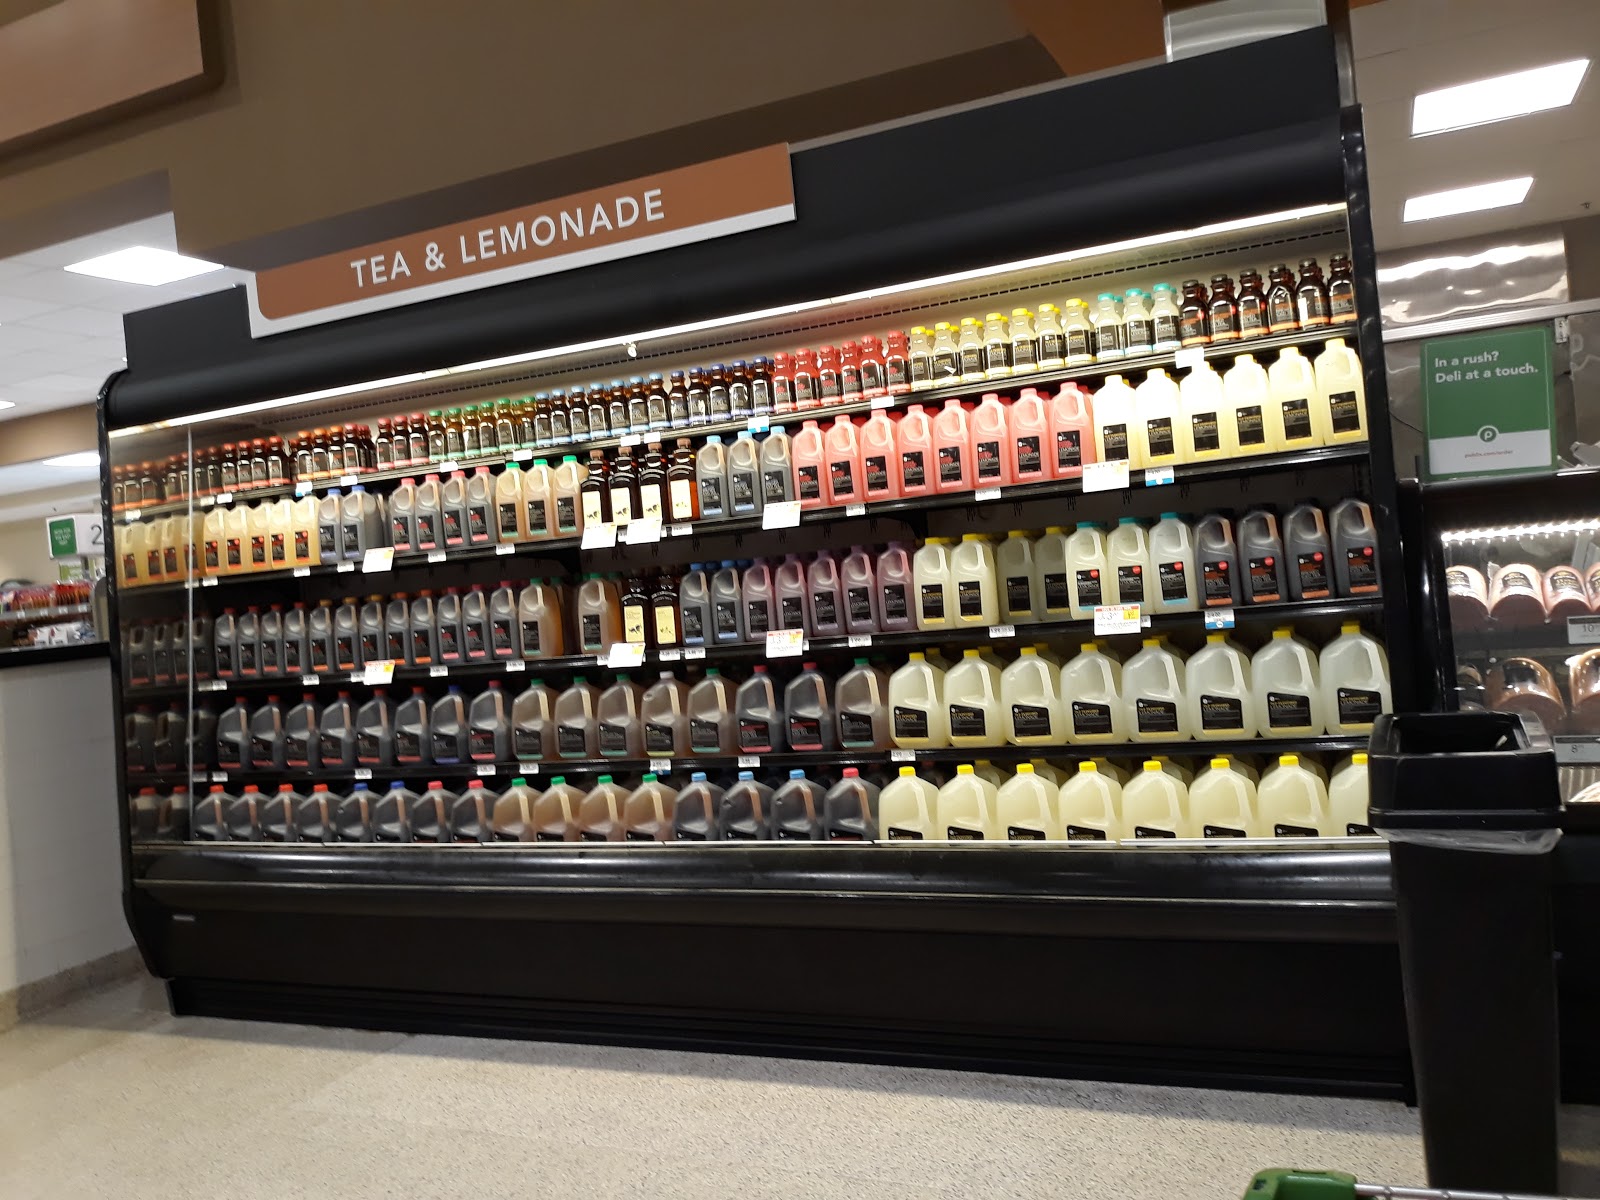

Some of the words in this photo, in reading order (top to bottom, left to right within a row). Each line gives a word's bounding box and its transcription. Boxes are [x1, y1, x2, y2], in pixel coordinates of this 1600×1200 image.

[350, 250, 411, 288] TEA
[424, 241, 446, 272] &
[459, 188, 665, 265] LEMONADE
[1434, 357, 1448, 368] In
[1451, 357, 1460, 366] a
[1463, 350, 1499, 365] rush?
[1435, 370, 1462, 383] Deli
[1465, 369, 1480, 380] at
[1483, 369, 1492, 378] a
[1495, 362, 1539, 377] touch.
